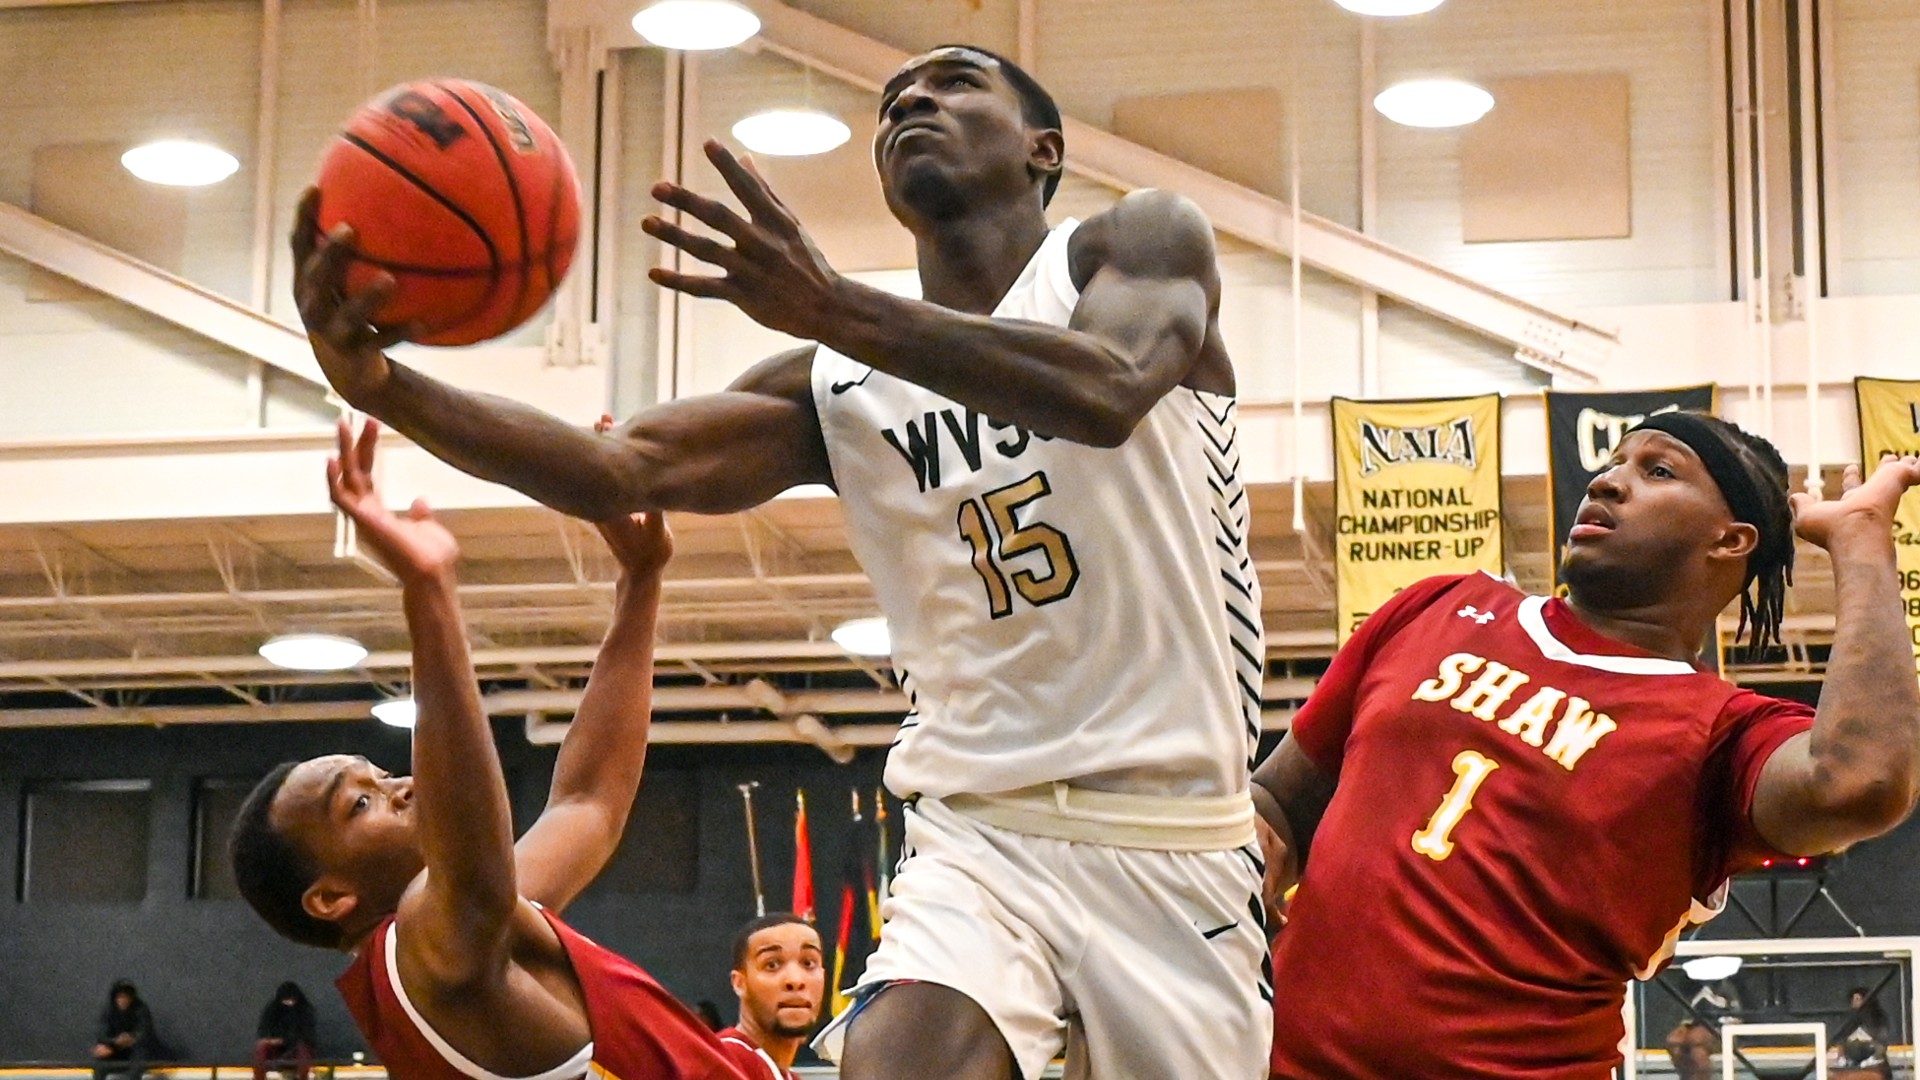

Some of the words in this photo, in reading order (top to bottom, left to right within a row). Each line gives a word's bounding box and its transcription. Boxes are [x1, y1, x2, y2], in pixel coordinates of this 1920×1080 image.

[881, 408, 1055, 493] WVS
[1359, 414, 1477, 477] NAIA
[1337, 509, 1498, 535] CHAMPIONSHIP
[1362, 487, 1472, 509] NATIONAL
[957, 470, 1080, 620] 15
[1349, 537, 1485, 562] RUNNER-UP
[1411, 652, 1617, 771] SHAW
[1411, 749, 1500, 861] 1
